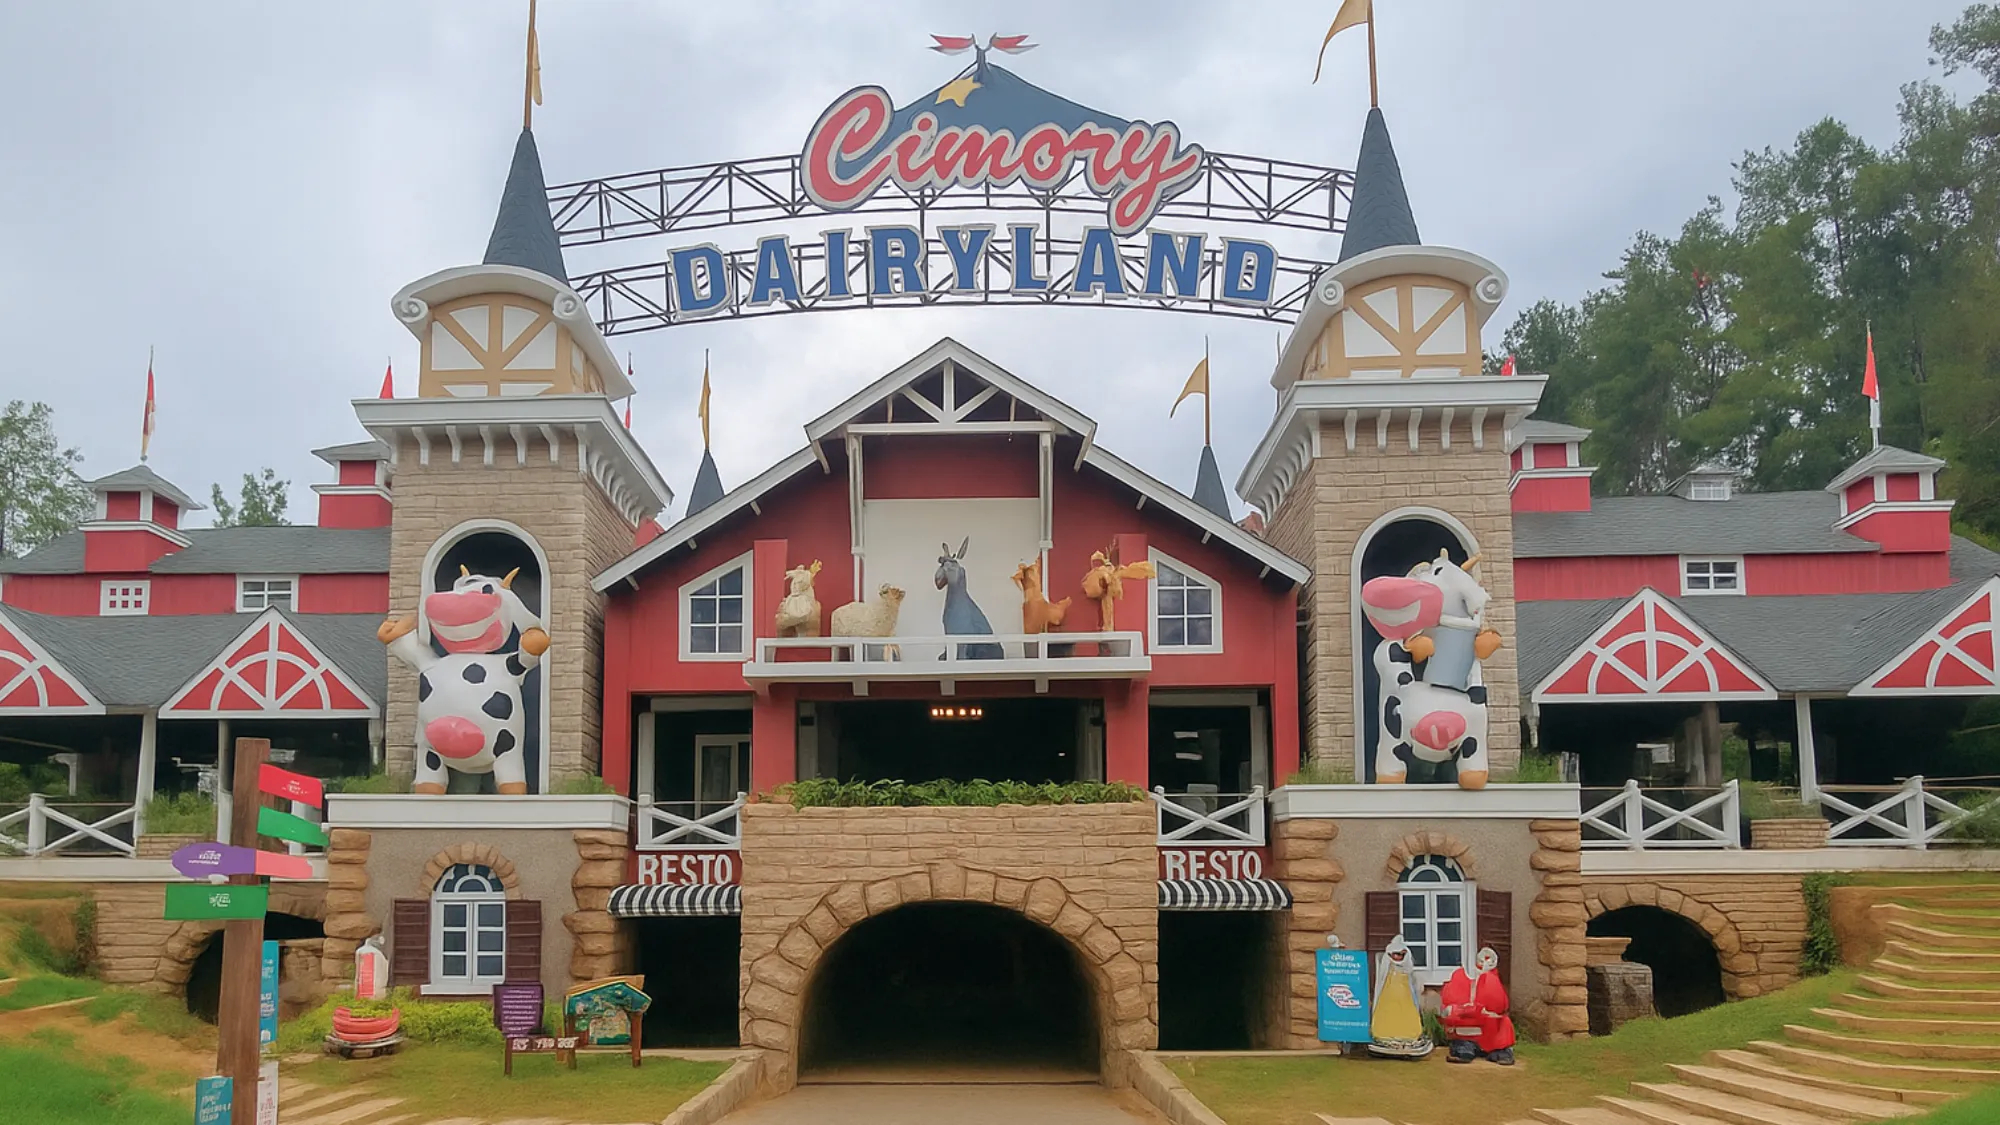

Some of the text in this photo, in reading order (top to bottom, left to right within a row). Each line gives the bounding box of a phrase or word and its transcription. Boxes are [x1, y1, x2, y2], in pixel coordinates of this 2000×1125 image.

[806, 90, 1201, 231] Cimory
[669, 226, 1277, 316] DAIRYLAND
[638, 853, 733, 886] RESTO
[1161, 850, 1262, 881] RESTO
